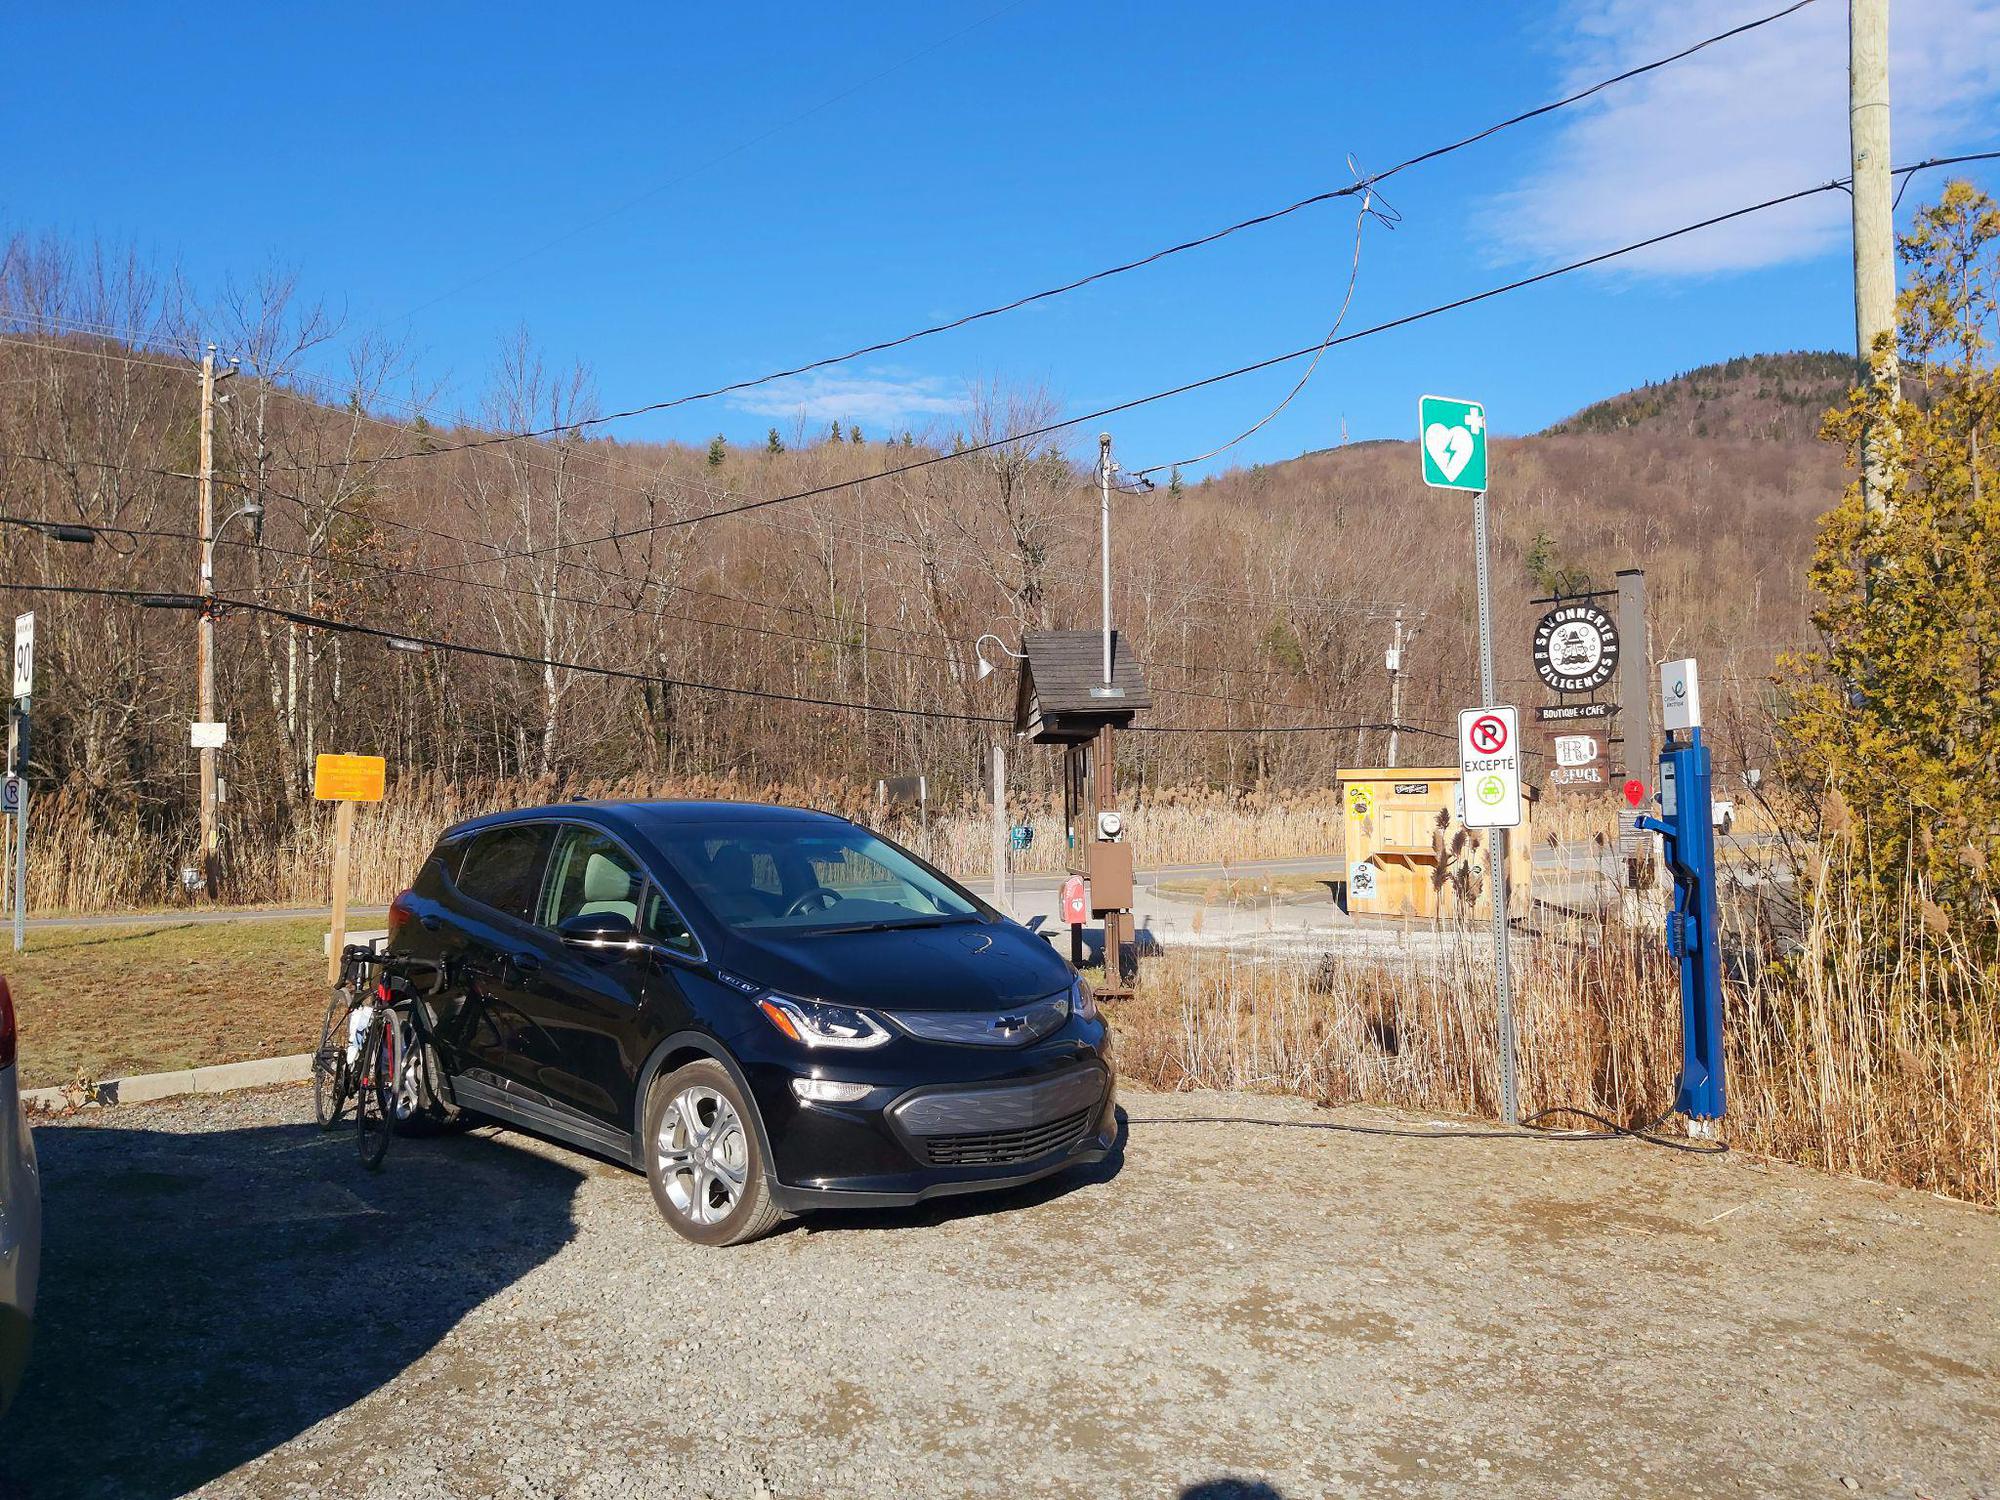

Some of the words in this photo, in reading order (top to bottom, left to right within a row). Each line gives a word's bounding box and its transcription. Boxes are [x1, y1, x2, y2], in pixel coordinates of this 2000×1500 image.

[1536, 608, 1613, 646] SAVONNERIE
[17, 642, 30, 682] 90
[1539, 658, 1613, 690] DILIGENCES
[1543, 708, 1579, 719] BOUTIQUE
[1585, 704, 1606, 716] CAFÉ
[1481, 724, 1497, 745] P
[1464, 756, 1515, 772] EXCEPTÉ
